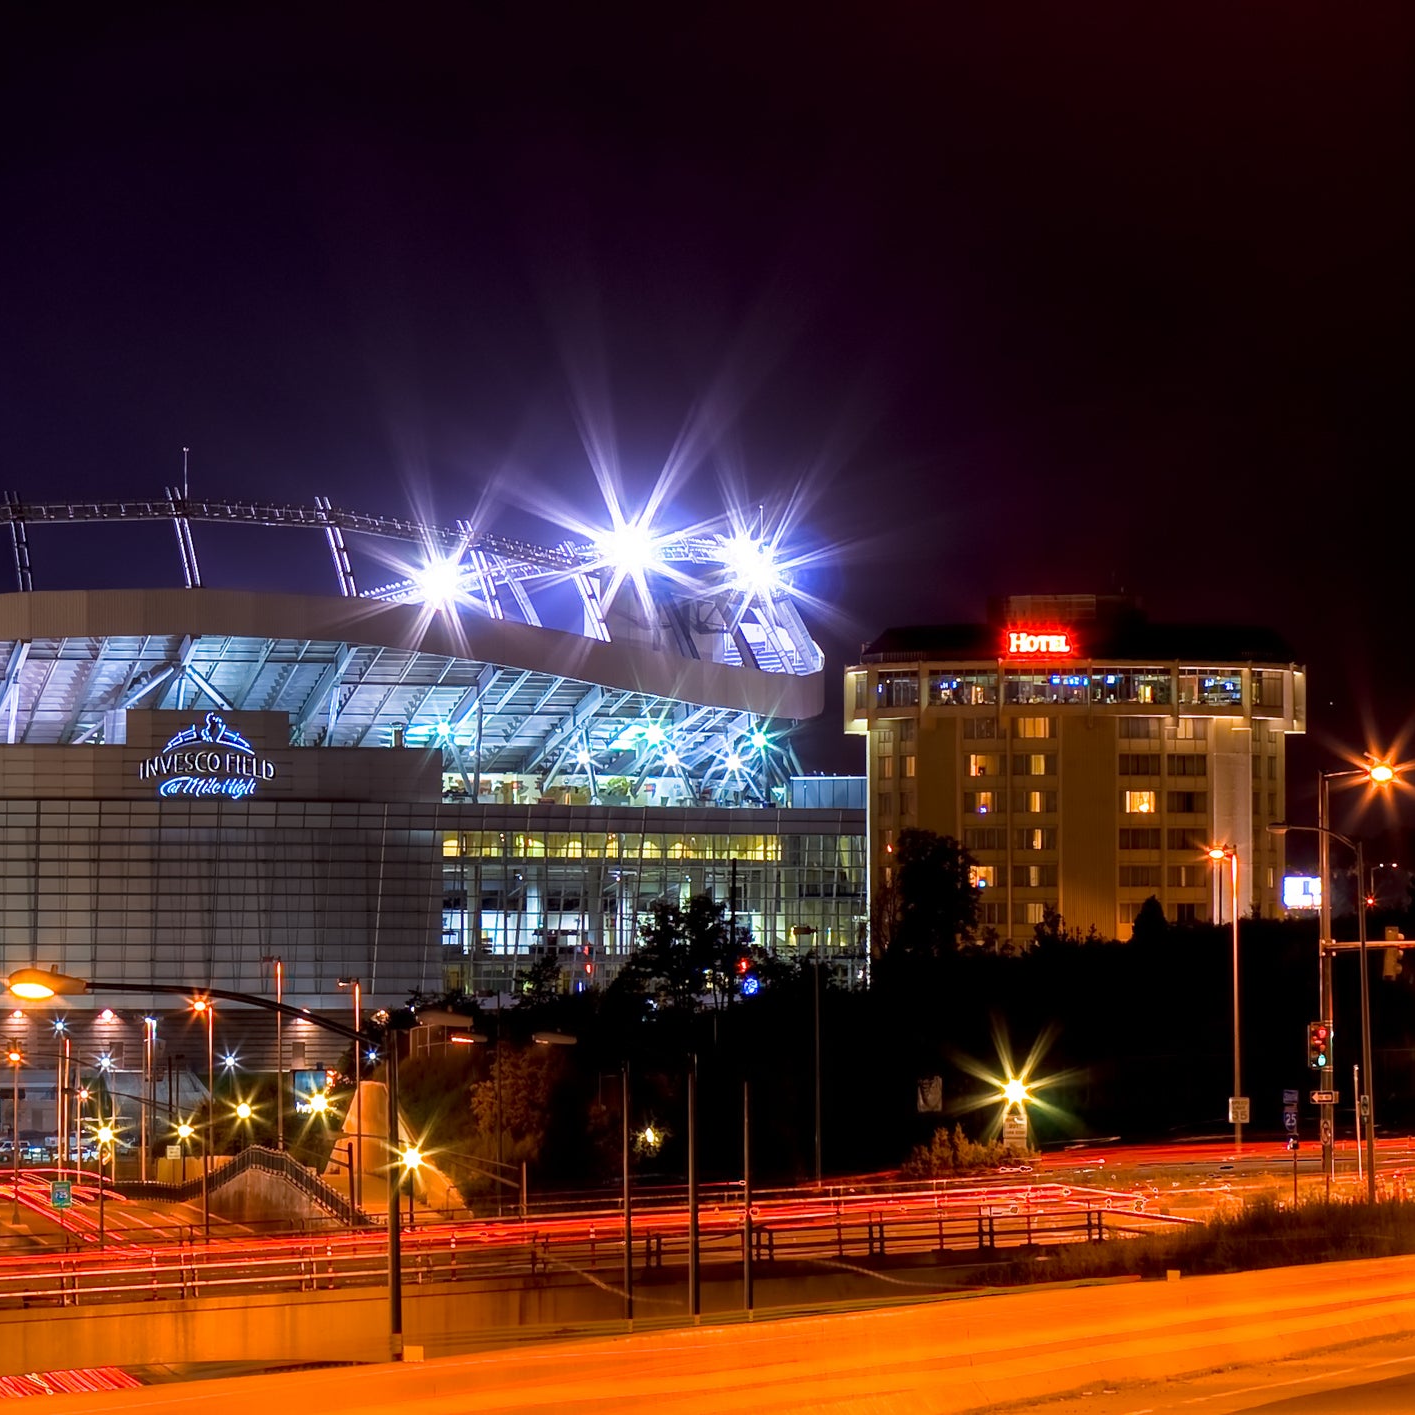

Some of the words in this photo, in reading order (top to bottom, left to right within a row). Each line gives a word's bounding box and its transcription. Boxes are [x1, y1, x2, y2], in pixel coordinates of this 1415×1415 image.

[140, 751, 221, 780] INVESCO
[226, 752, 275, 781] FIELD
[183, 777, 221, 797] Mile
[221, 778, 256, 799] High
[1285, 1113, 1297, 1126] 25
